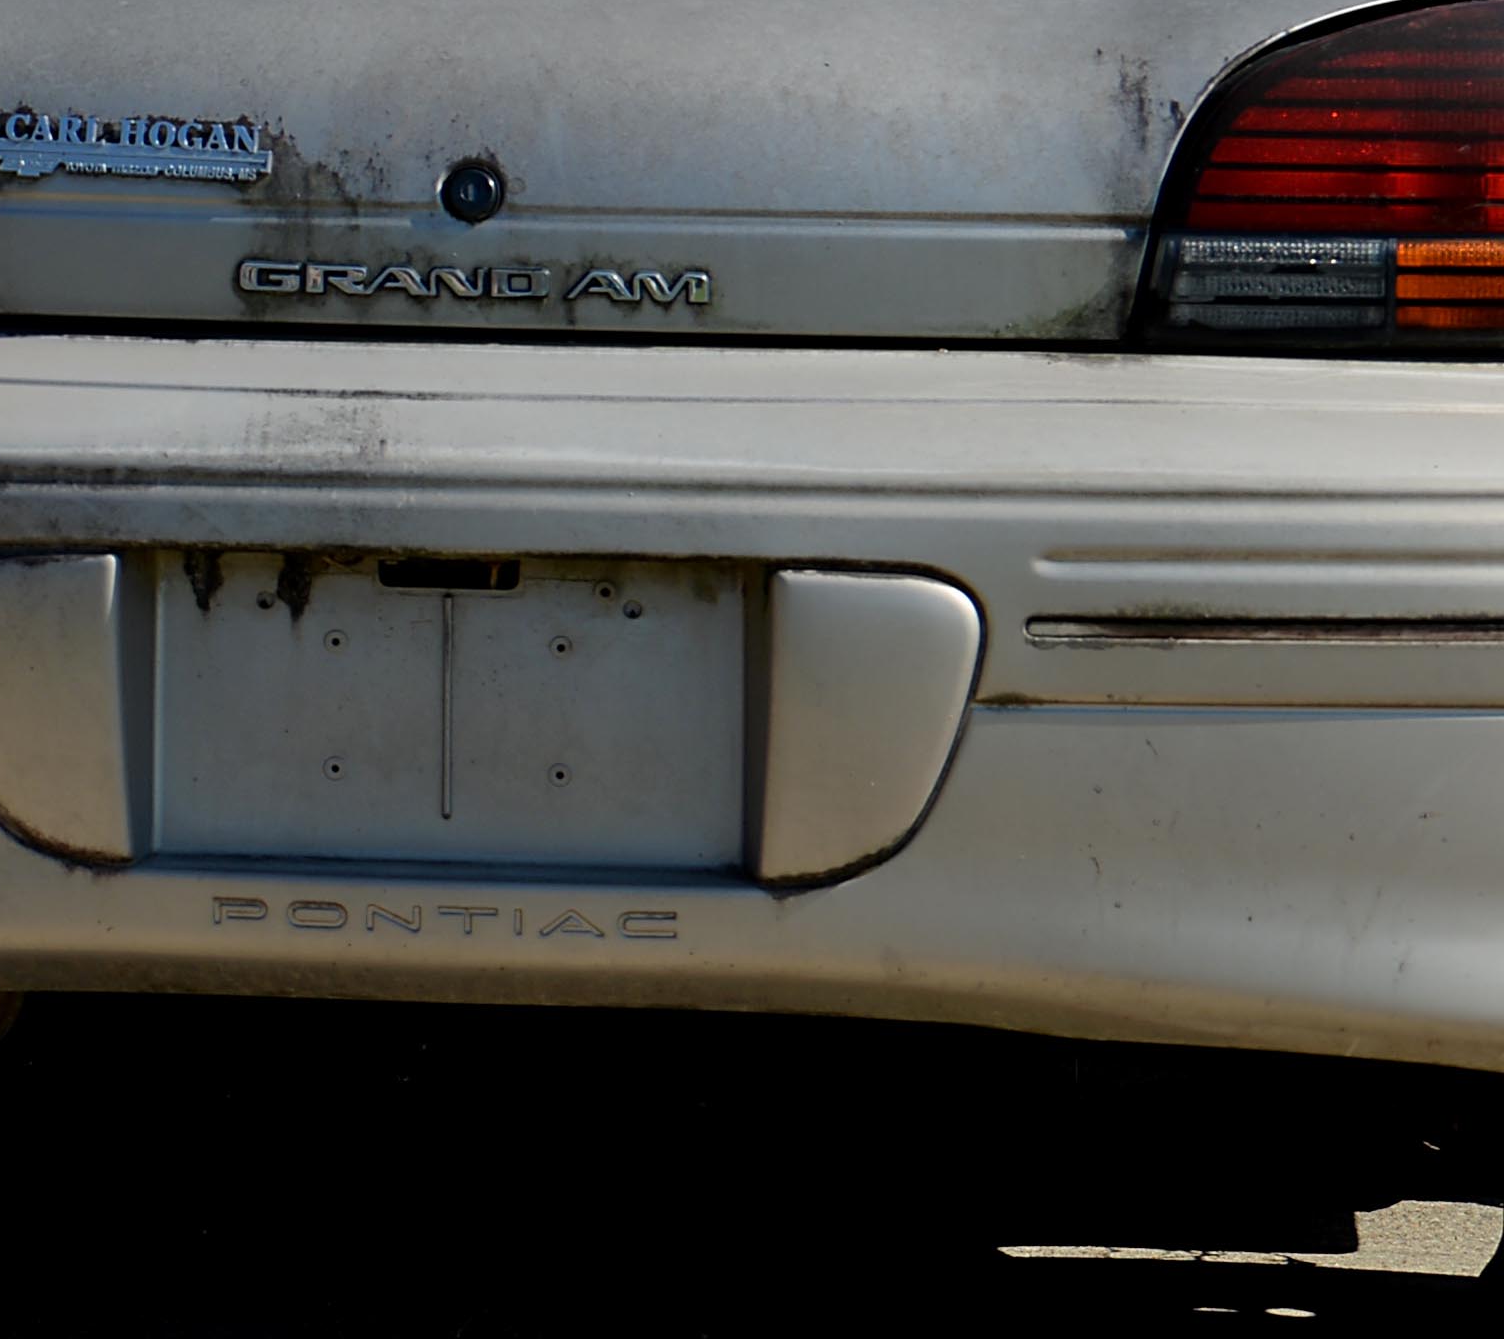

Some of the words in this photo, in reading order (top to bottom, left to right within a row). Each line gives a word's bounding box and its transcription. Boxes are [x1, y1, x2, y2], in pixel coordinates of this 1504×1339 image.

[5, 113, 106, 146] CARL
[119, 117, 262, 154] HOGAN
[239, 260, 553, 298] GRAND
[566, 268, 713, 304] AM
[212, 896, 678, 939] PONTIAC
